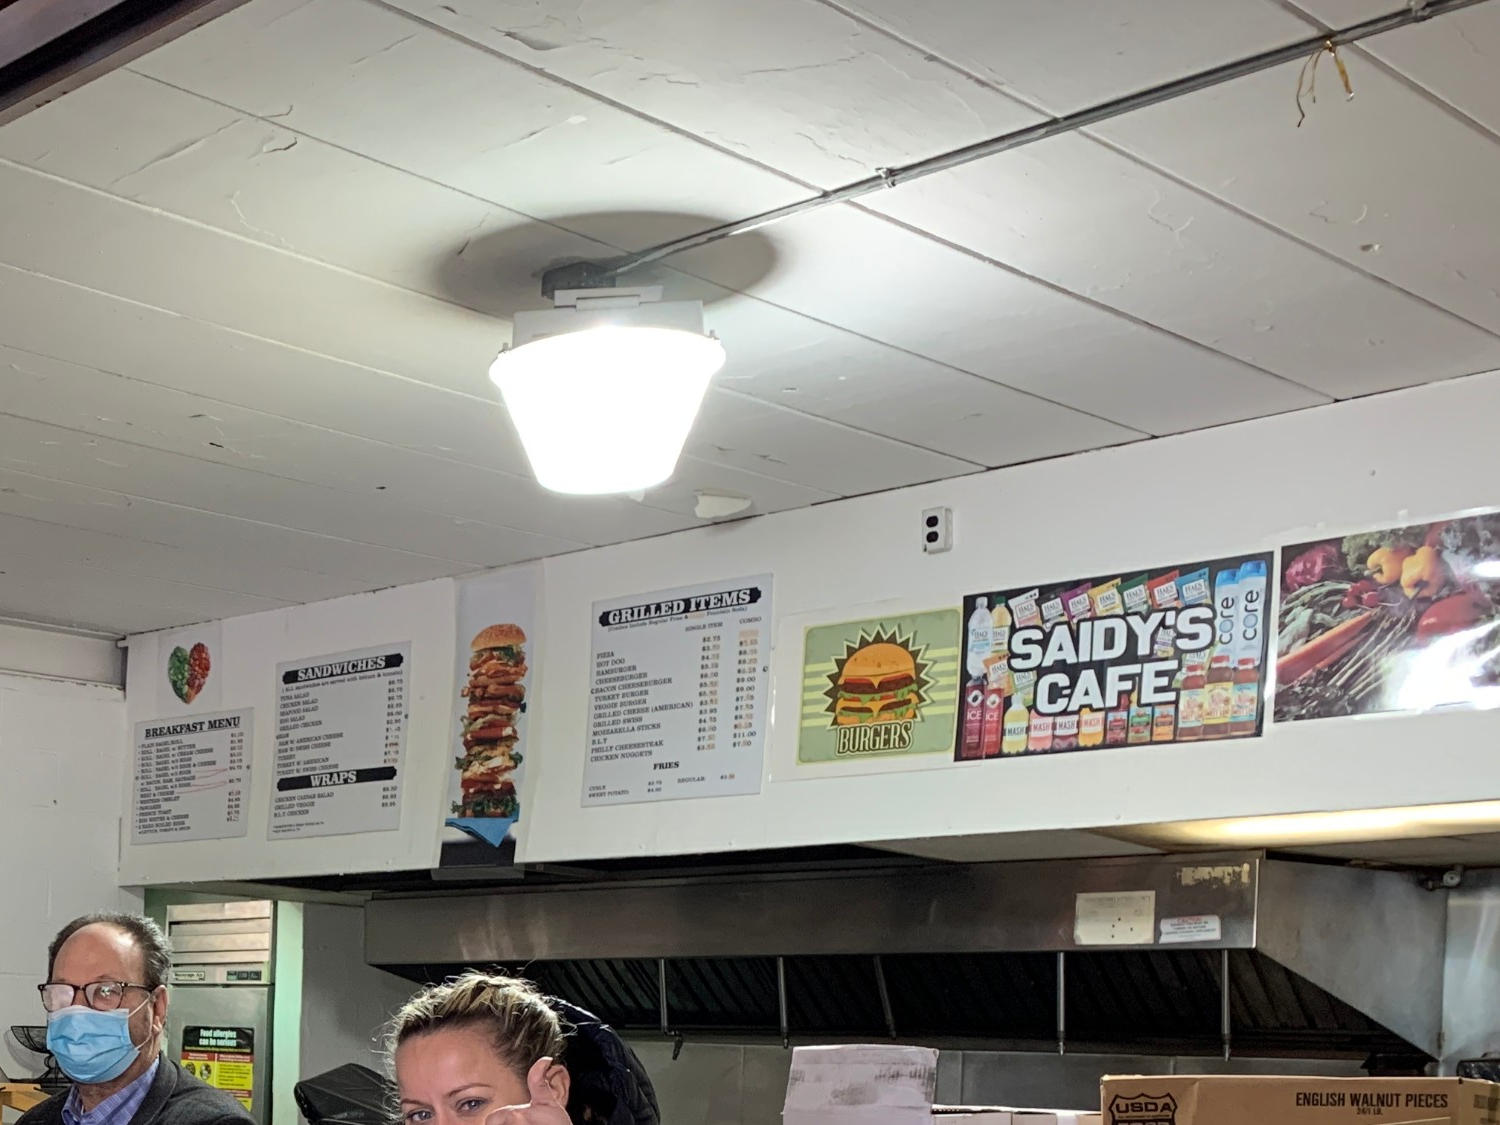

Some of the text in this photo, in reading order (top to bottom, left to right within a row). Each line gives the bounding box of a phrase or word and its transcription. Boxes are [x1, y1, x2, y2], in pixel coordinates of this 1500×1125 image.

[609, 589, 750, 624] GRILLED ITEMS
[1219, 597, 1234, 645] core
[1243, 589, 1259, 641] core
[1010, 606, 1213, 670] SAIDY'S
[297, 656, 386, 681] SANDWICHES
[596, 665, 637, 677] HAMBURGER
[595, 672, 647, 685] CHEESEBURGER
[618, 677, 673, 691] CHEESEBURGER
[1036, 660, 1178, 714] CAFE
[595, 689, 649, 703] TURKEY BURGER
[593, 702, 693, 720] GRILLED CHEESE (AMERICAN)
[594, 698, 647, 711] VEGGIE BURGER
[967, 711, 982, 720] ICE
[986, 712, 998, 721] ICE
[1084, 717, 1101, 727] MASH
[145, 716, 240, 738] BREAKFAST MENU
[593, 719, 621, 728] GRILLED
[1033, 722, 1050, 731] MASH
[1058, 720, 1075, 729] MASH
[837, 722, 911, 753] BURGERS
[1006, 727, 1024, 736] MASH
[591, 745, 614, 754] PHILLY
[615, 740, 664, 752] CHEESESTEAK
[590, 750, 653, 763] CHICKEN NUGGETS
[653, 761, 680, 770] FRIES
[310, 770, 357, 787] WRAPS
[200, 1029, 237, 1039] Food allergies
[199, 1038, 237, 1047] can be serious
[1115, 1100, 1173, 1114] USDA
[1296, 1092, 1448, 1109] ENGLISH WALNUT PIECES
